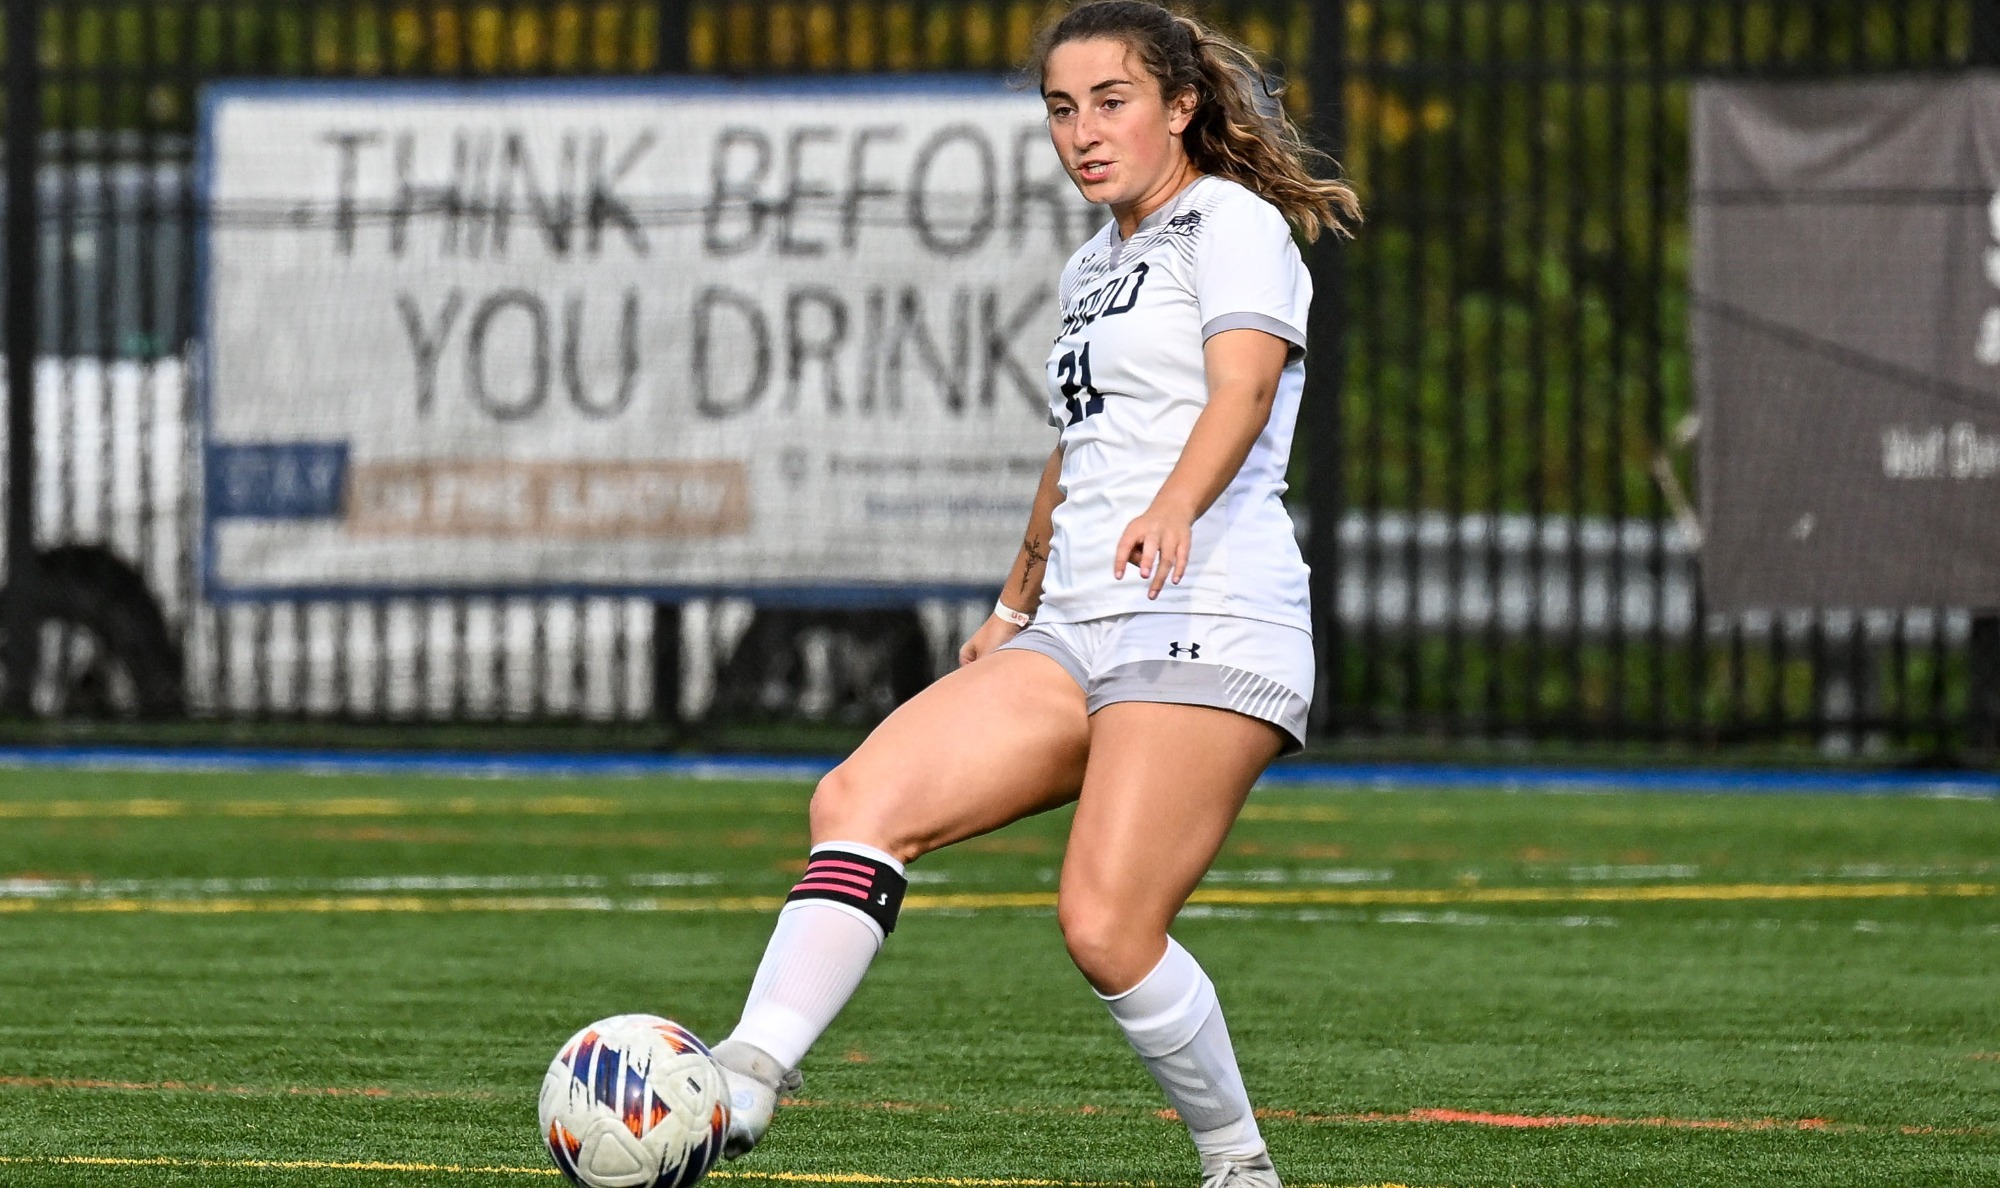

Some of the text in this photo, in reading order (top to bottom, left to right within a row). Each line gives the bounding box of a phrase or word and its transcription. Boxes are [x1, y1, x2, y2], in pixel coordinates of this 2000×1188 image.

[323, 122, 1104, 258] THINK BEFOR
[398, 284, 1051, 423] YOU DRINK
